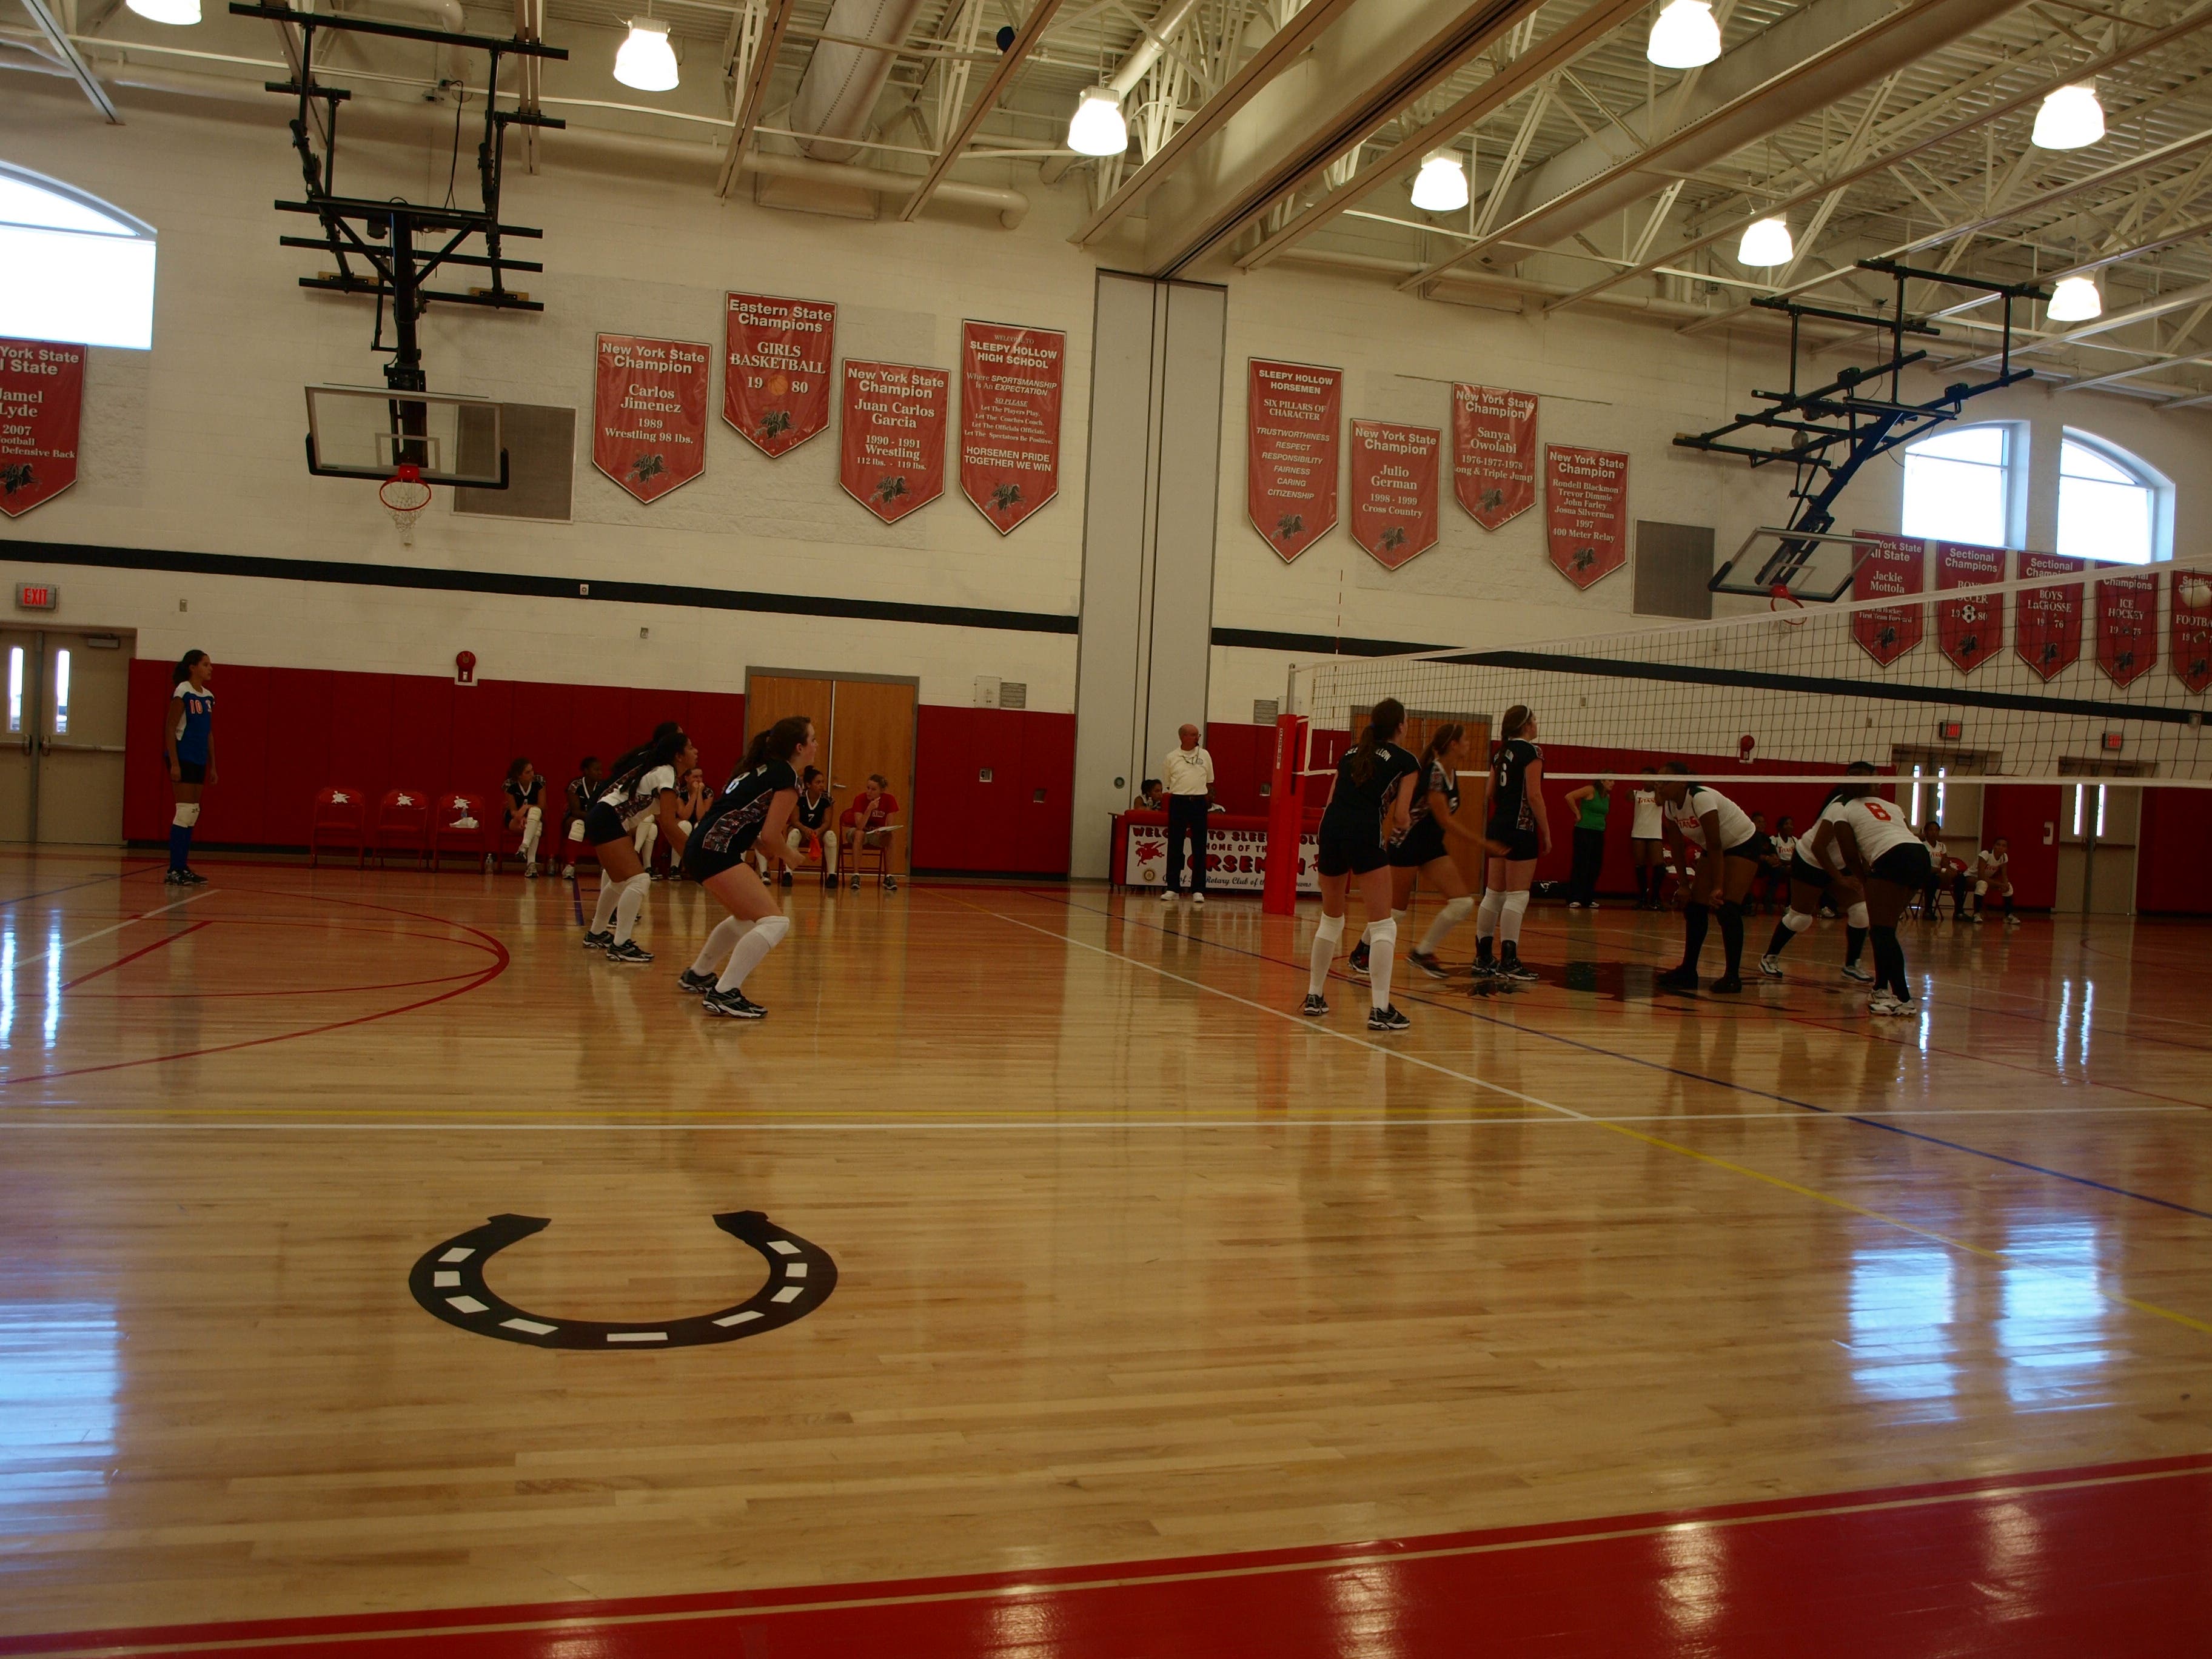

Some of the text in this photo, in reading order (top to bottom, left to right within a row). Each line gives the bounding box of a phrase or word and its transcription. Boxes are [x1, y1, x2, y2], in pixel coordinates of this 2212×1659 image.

[729, 300, 832, 321] Eastern State
[739, 313, 822, 332] Champions
[0, 346, 79, 363] York State
[602, 343, 705, 363] New York State
[757, 342, 801, 357] GIRLS
[970, 341, 1057, 359] SLEEPY HOLLOW
[11, 359, 58, 375] State
[614, 356, 692, 374] Champion
[731, 354, 825, 374] BASKETBALL
[977, 353, 1048, 369] HIGH SCHOOL
[848, 368, 944, 387] New York State
[991, 375, 1057, 389] SPORTSMANSHIP
[1259, 370, 1333, 386] SLEEPY HOLLOW
[629, 384, 674, 399] Carlos
[748, 377, 808, 393] 19 80
[859, 381, 933, 398] Champion
[995, 384, 1048, 396] EXPECTATION
[1271, 381, 1321, 394] HORSEMEN
[621, 397, 681, 413] Jimenez
[1264, 399, 1277, 407] SIX
[1279, 401, 1313, 411] PILLARS
[1456, 391, 1534, 409] New York State
[854, 399, 934, 417] Juan Carlos
[1269, 409, 1319, 420] CHARACTER
[1466, 401, 1525, 419] Champion
[638, 418, 663, 429] 1989
[872, 414, 917, 428] Garcia
[3, 424, 32, 436] 2007
[605, 427, 656, 443] Wrestling
[675, 434, 693, 444] lbs.
[989, 432, 1018, 441] Spectators
[1257, 427, 1330, 441] TRUSTWORTHINESS
[1356, 428, 1436, 445] New York State
[1478, 427, 1510, 441] Sanya
[866, 435, 920, 448] 1990 1991
[1276, 441, 1311, 451] RESPECT
[1365, 439, 1427, 455] Champion
[1470, 438, 1517, 454] Owolabi
[2, 446, 75, 458] Defensive Back
[865, 444, 920, 461] Wrestling
[967, 446, 1049, 462] HORSEMEN PRIDE
[1262, 452, 1323, 464] RESPONSIBILITY
[964, 455, 1051, 471] TOGETHER WE WIN
[1550, 452, 1624, 469] New York State
[1274, 466, 1310, 475] FAIRNESS
[1380, 465, 1409, 477] Julio
[1483, 468, 1507, 480] Triple
[1510, 471, 1532, 483] Jump
[1558, 463, 1615, 479] Champion
[1277, 478, 1305, 486] CARING
[1371, 476, 1417, 490] German
[1553, 479, 1581, 489] Rondell
[1268, 489, 1314, 500] CITIZENSHIP
[1370, 494, 1417, 505] 1998 1999
[1558, 489, 1583, 497] Trevor
[1362, 504, 1423, 518] Cross Country
[1584, 501, 1607, 511] Farley
[1578, 509, 1614, 519] Silverman
[1576, 520, 1594, 528] 1997
[1569, 530, 1591, 539] Meter
[1594, 532, 1615, 543] Relay
[1879, 540, 1922, 552] York State
[1884, 551, 1910, 561] State
[1950, 548, 1994, 561] Sectional
[1945, 557, 1997, 572] Champions
[2031, 558, 2073, 571] Sectional
[1873, 571, 1903, 582] Jackie
[24, 588, 47, 605] EXIT
[2040, 589, 2063, 600] BOYS
[2120, 598, 2134, 608] ICE
[1208, 830, 1225, 841] TO
